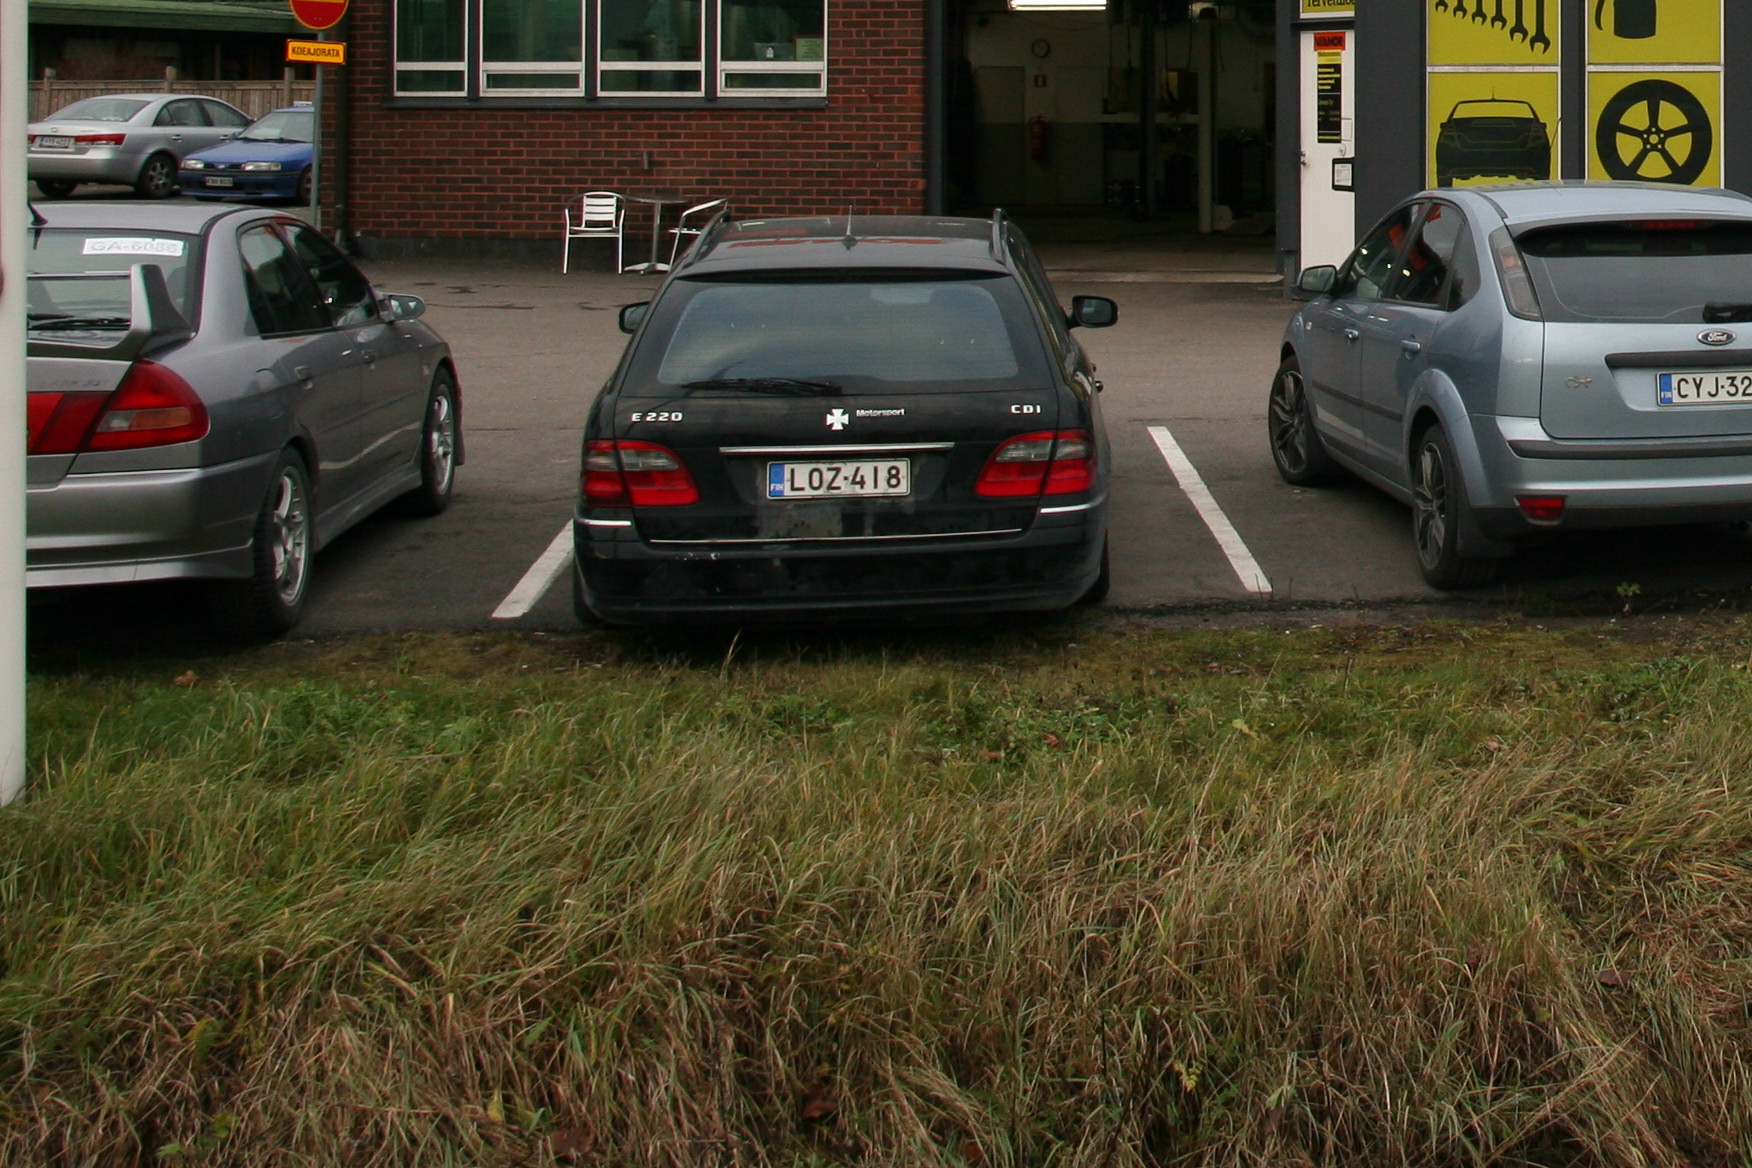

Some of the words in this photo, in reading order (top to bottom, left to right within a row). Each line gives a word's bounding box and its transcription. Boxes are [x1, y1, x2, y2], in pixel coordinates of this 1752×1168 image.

[291, 46, 341, 58] KOEAJORATA
[1707, 331, 1728, 342] Ford
[856, 408, 905, 417] Motorsport
[1010, 404, 1042, 414] CDI
[631, 412, 643, 422] E
[645, 411, 684, 422] 220
[789, 464, 902, 492] LOZ-418
